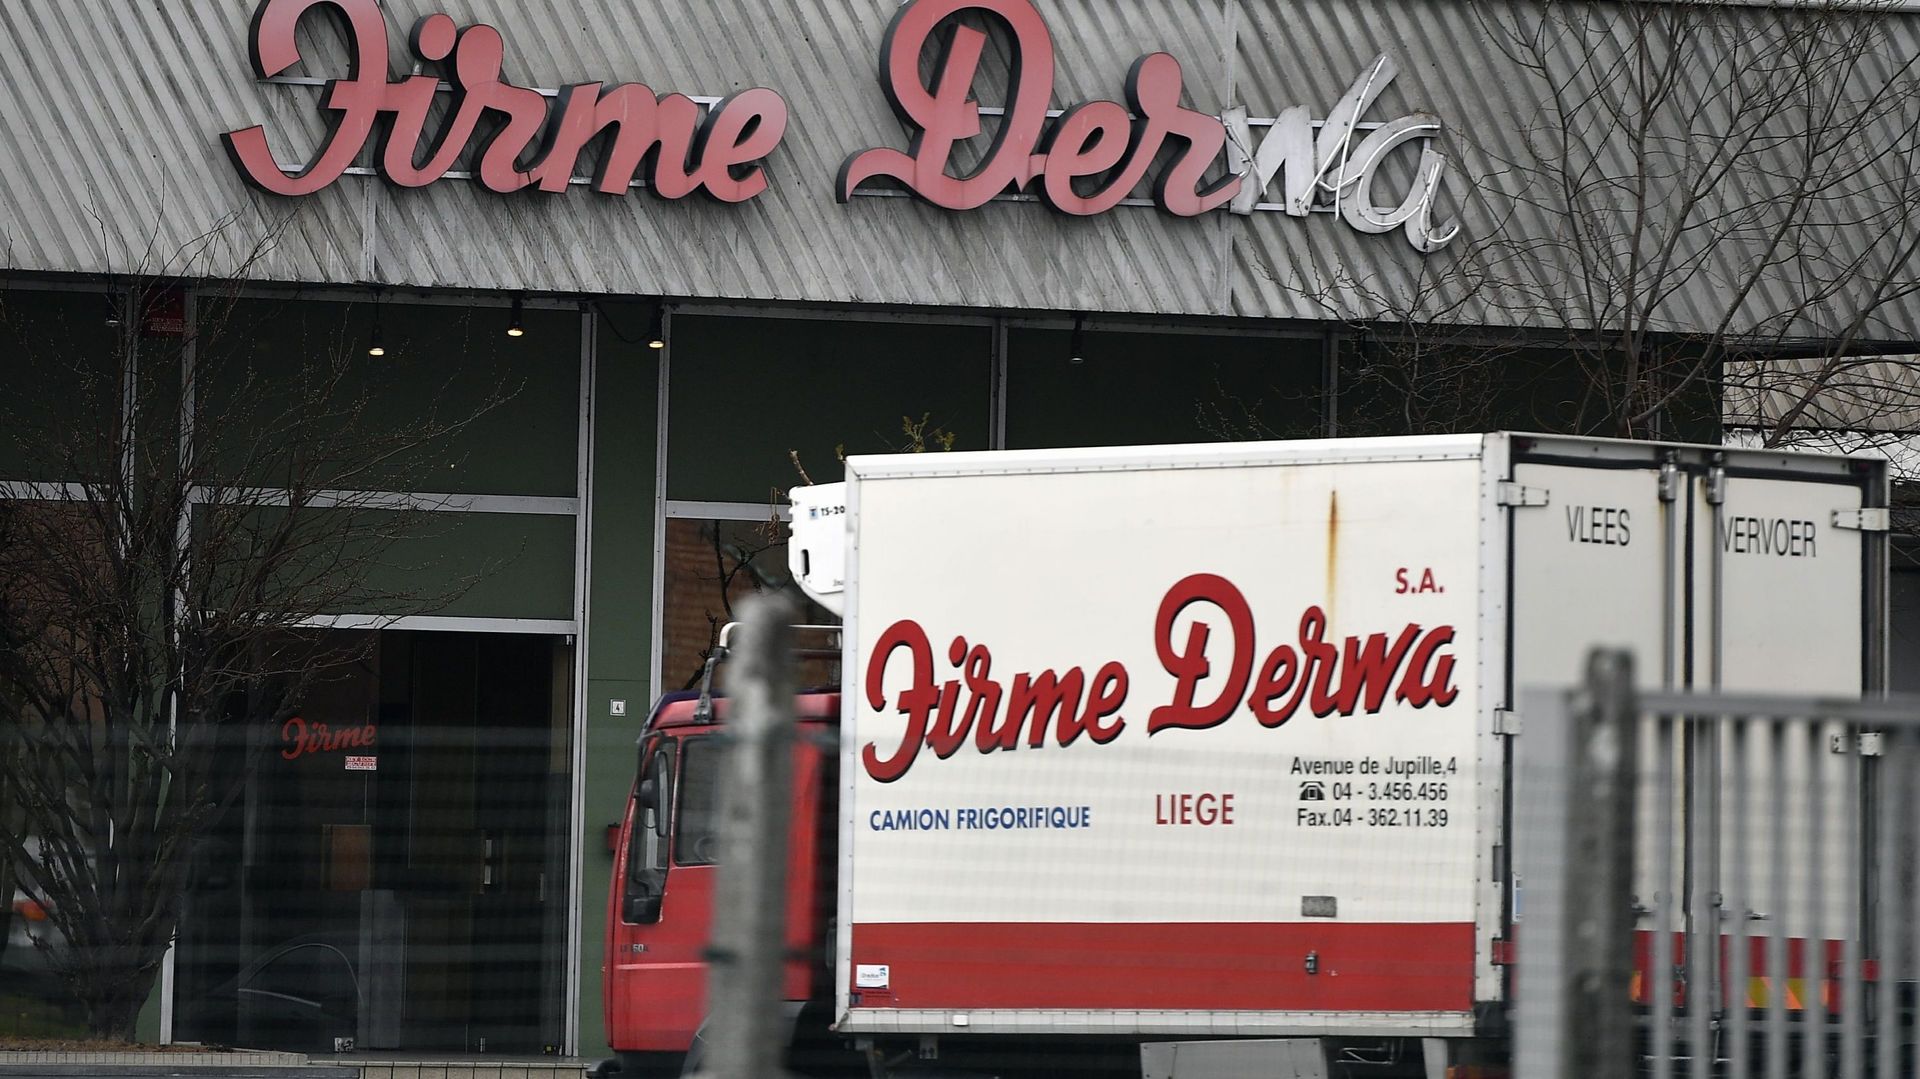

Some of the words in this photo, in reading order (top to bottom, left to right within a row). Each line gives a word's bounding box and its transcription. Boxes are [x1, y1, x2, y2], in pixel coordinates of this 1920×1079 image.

[220, 0, 789, 203] Firme
[836, 0, 1460, 253] Derwa
[1567, 504, 1632, 546] VLEES
[1720, 515, 1817, 558] VERVOER
[1395, 567, 1445, 595] S.A.
[862, 619, 1129, 783] Firme
[1147, 573, 1459, 736] Derwa
[281, 716, 377, 760] Firme
[1290, 756, 1354, 775] Avenue
[1359, 756, 1380, 775] de
[1384, 756, 1458, 780] Jupille,4
[1332, 782, 1353, 801] 04
[1368, 782, 1449, 801] 3.456.456
[870, 809, 949, 831] CAMION
[956, 806, 1090, 830] FRIGORIFIQUE
[1155, 793, 1235, 825] LIEGE
[1367, 808, 1449, 828] 362.11.39
